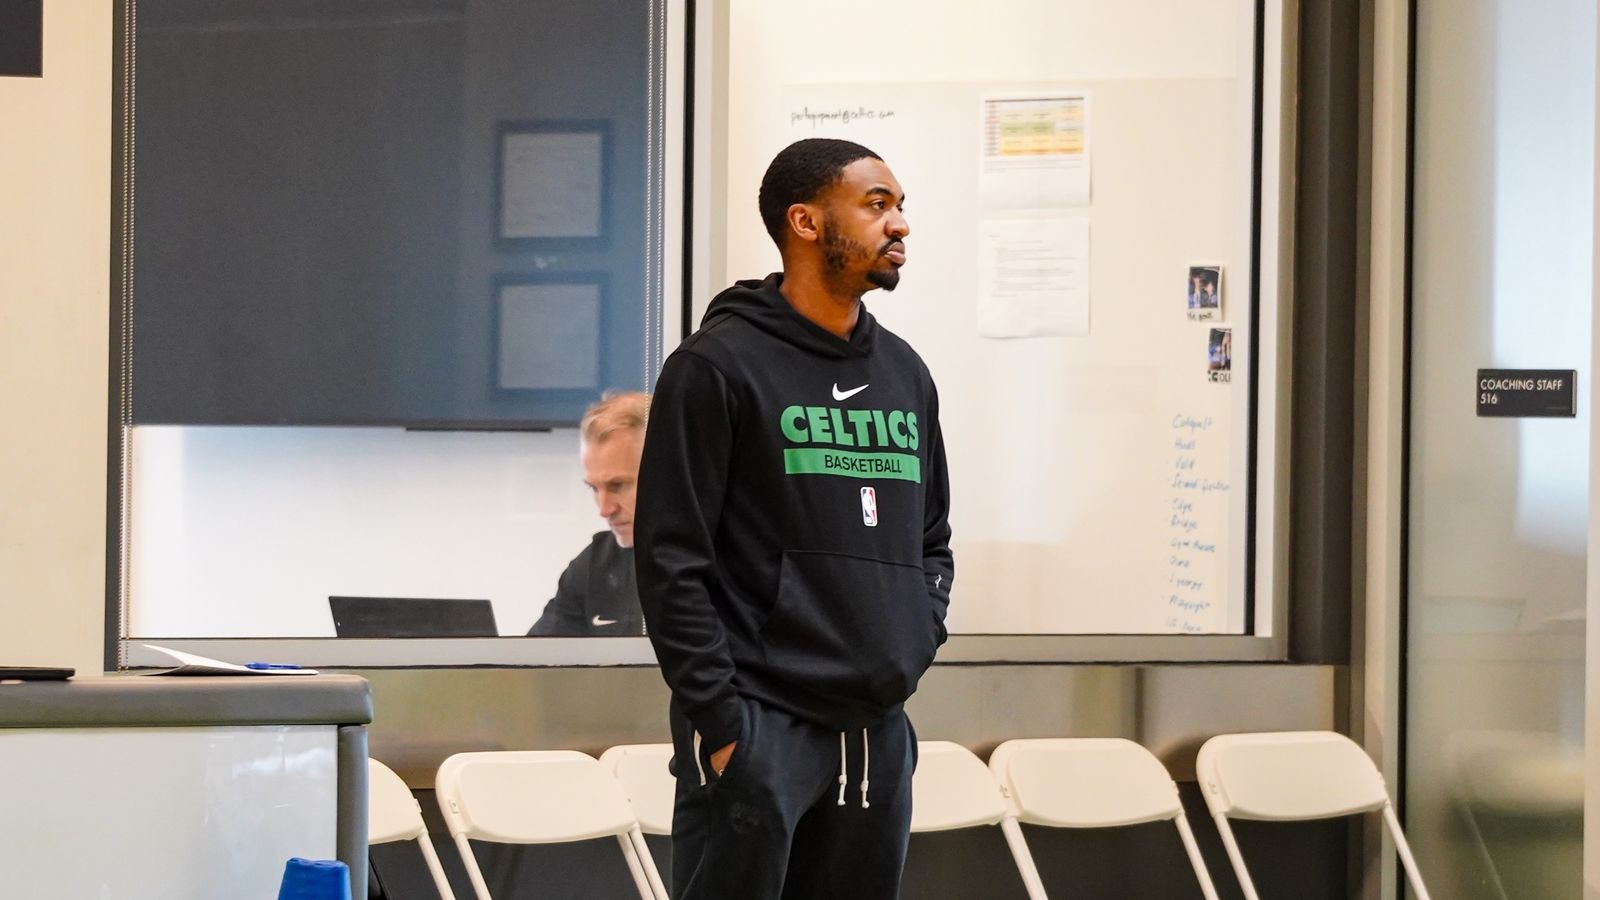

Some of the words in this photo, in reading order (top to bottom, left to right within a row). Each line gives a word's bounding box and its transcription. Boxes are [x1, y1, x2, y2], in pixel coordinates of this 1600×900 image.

[1480, 379, 1534, 391] COACHING
[1536, 379, 1562, 391] STAFF
[780, 405, 919, 451] CELTICS
[824, 454, 902, 474] BASKETBALL
